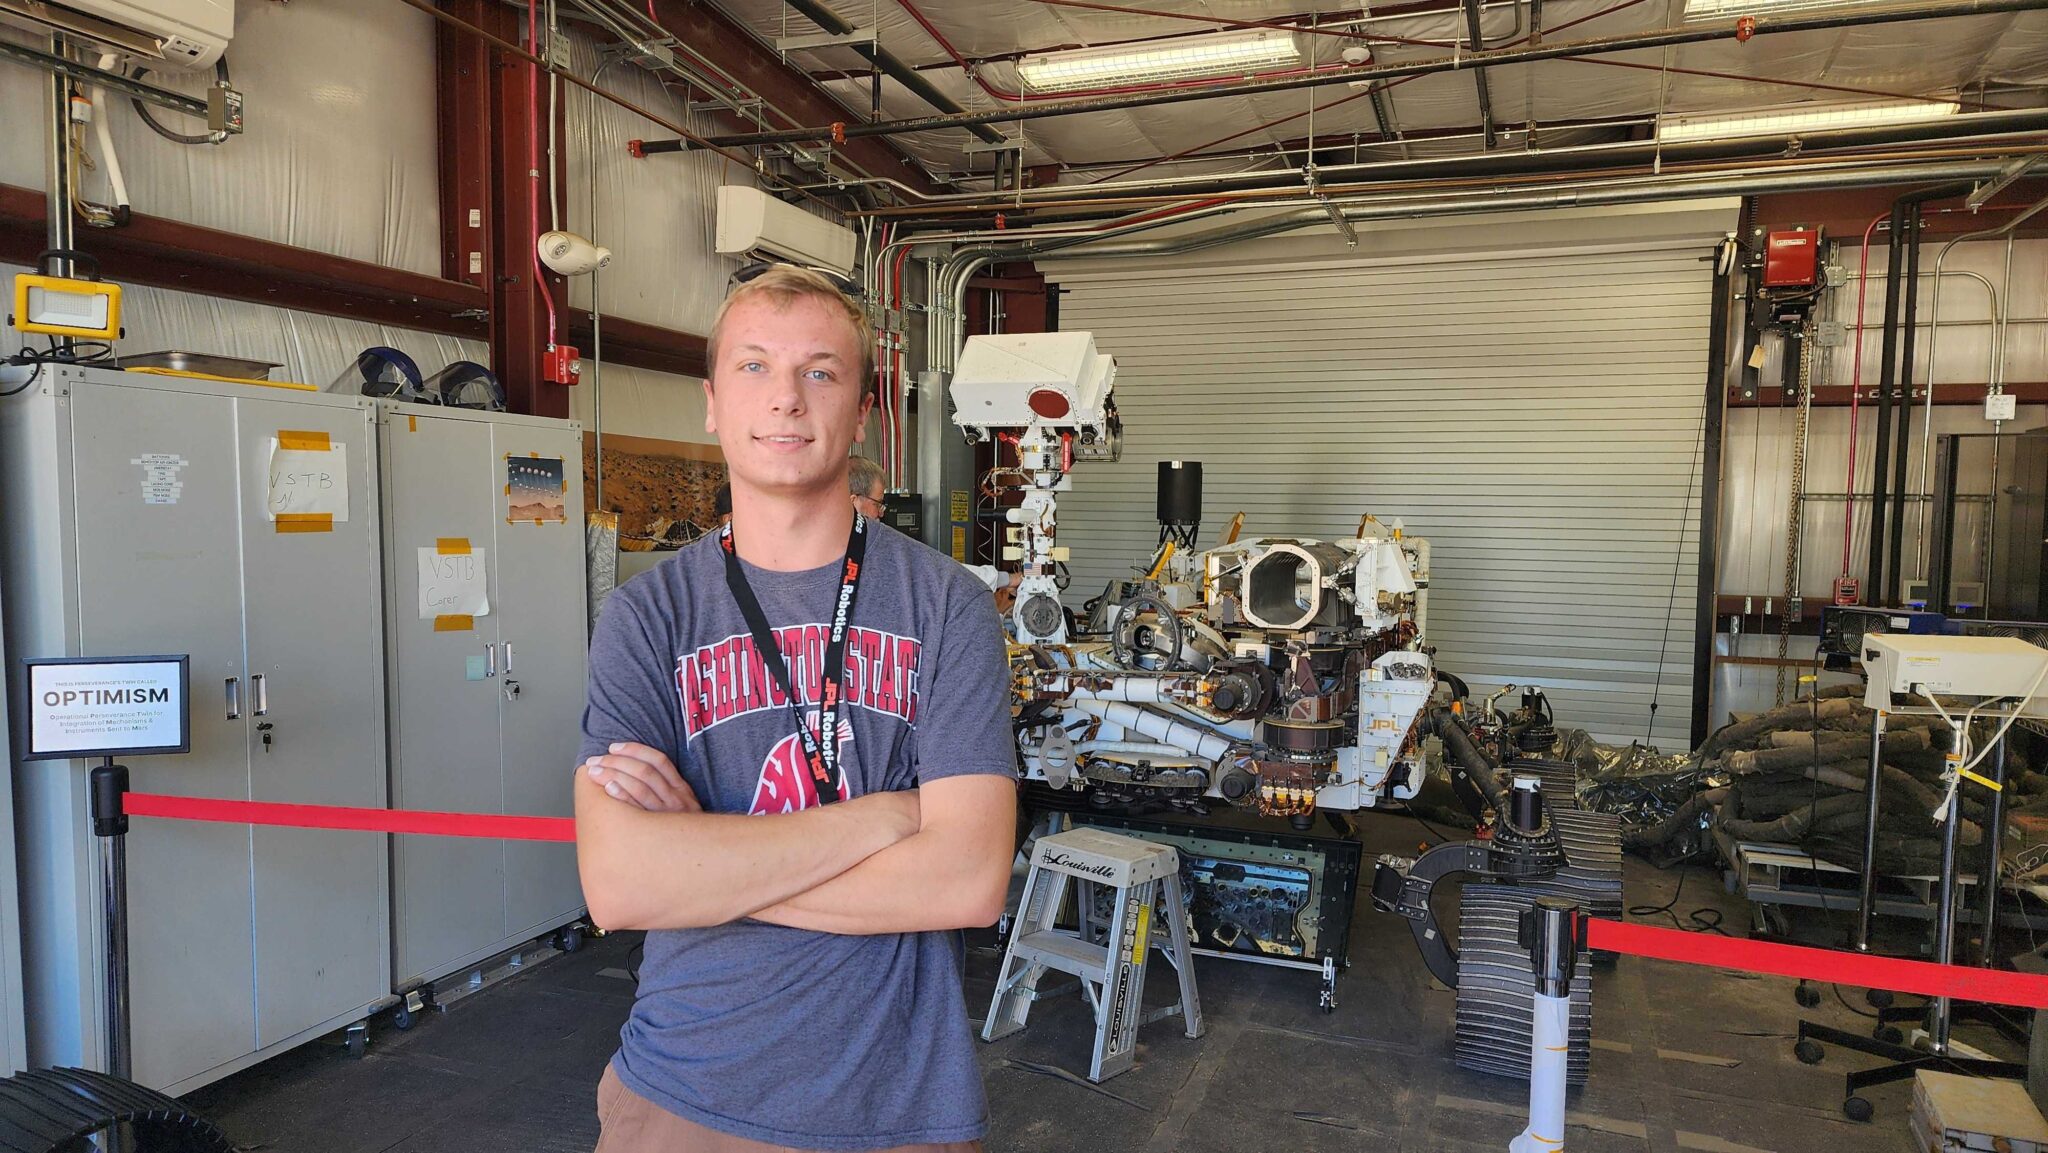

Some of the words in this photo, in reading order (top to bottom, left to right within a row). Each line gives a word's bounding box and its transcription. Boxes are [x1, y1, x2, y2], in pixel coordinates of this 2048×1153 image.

[270, 471, 333, 489] VSTB
[429, 555, 475, 581] VSTB
[844, 558, 859, 585] JPL
[426, 586, 458, 607] Corer
[832, 584, 855, 643] Robotics
[43, 688, 169, 707] OPTIMISM
[823, 677, 838, 711] JPL
[50, 713, 89, 721] Operational
[90, 711, 135, 719] Perseverance
[60, 720, 96, 728] Integration
[1367, 719, 1401, 731] JPL
[822, 711, 835, 769] Roboti
[810, 750, 830, 783] JPL
[1047, 854, 1115, 878] Louisville
[1112, 964, 1130, 1039] LOUISVILLE
